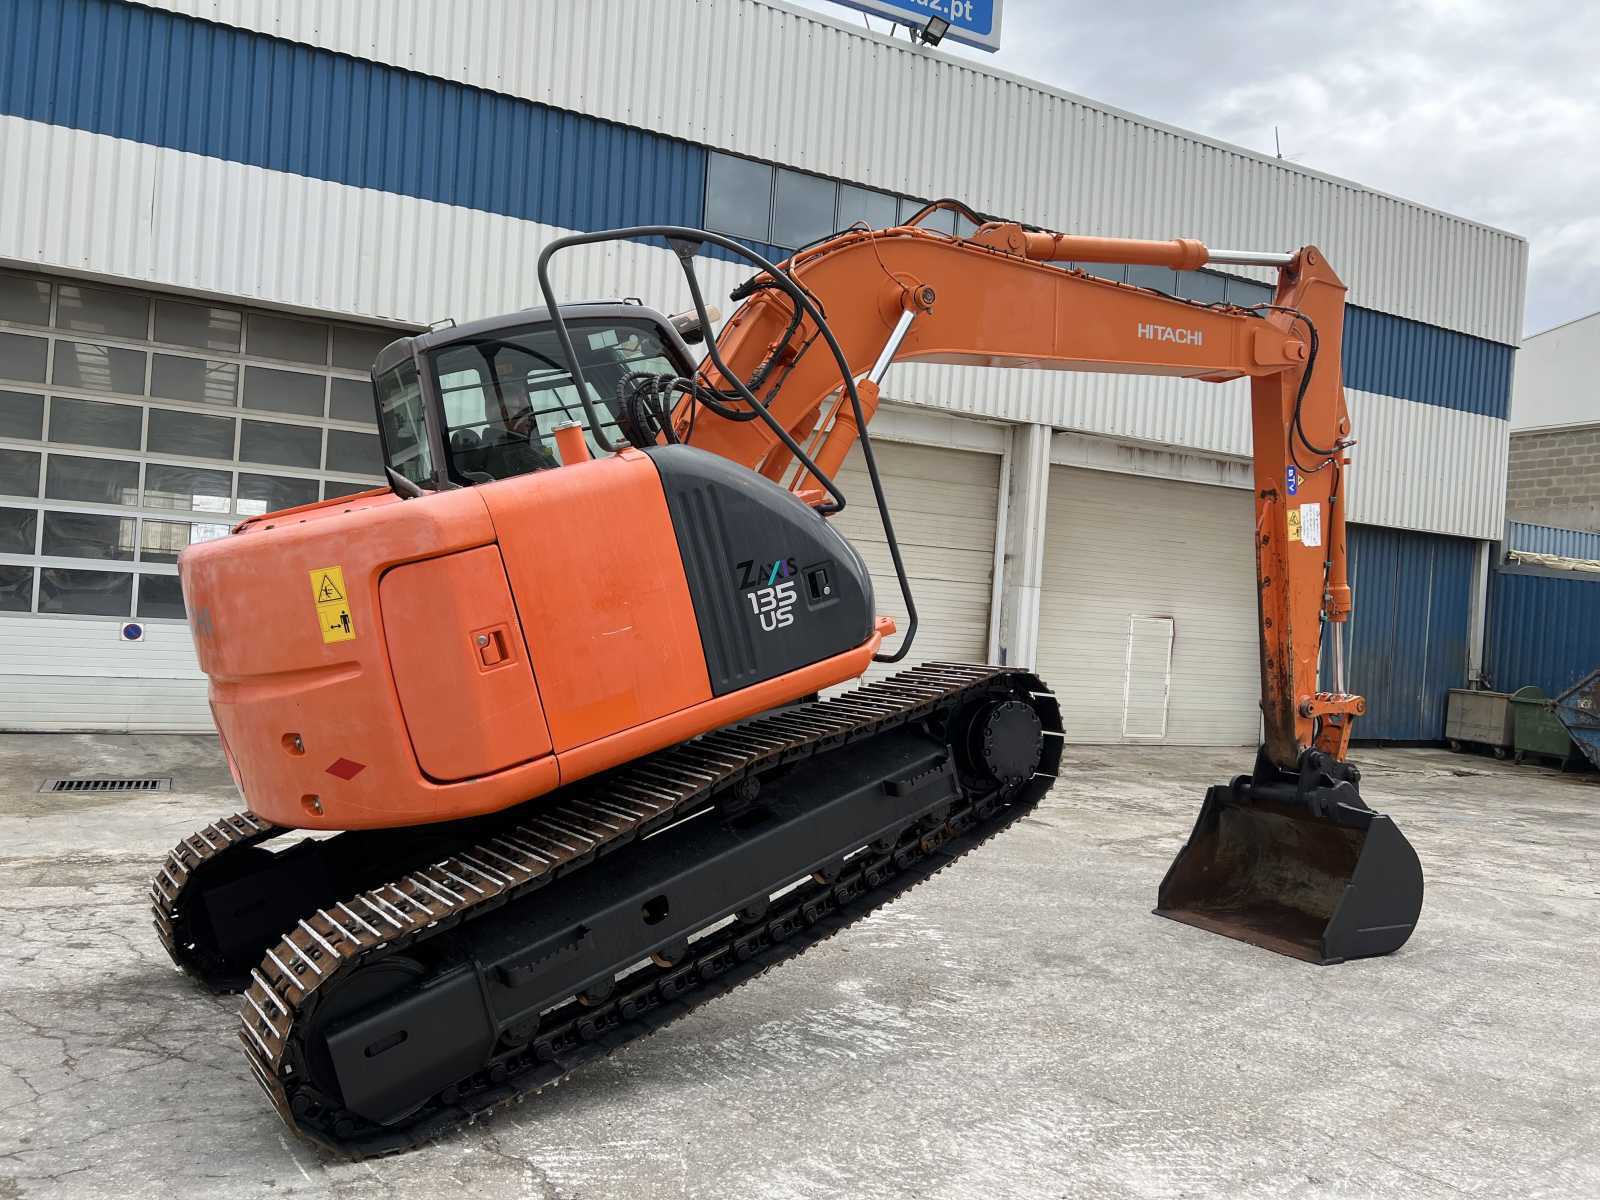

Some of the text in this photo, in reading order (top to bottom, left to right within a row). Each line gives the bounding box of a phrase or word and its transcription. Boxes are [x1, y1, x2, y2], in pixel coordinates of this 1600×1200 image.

[1138, 322, 1202, 346] HITACHI
[736, 557, 798, 590] ZAXIS
[748, 581, 797, 614] 135
[760, 606, 794, 631] US
